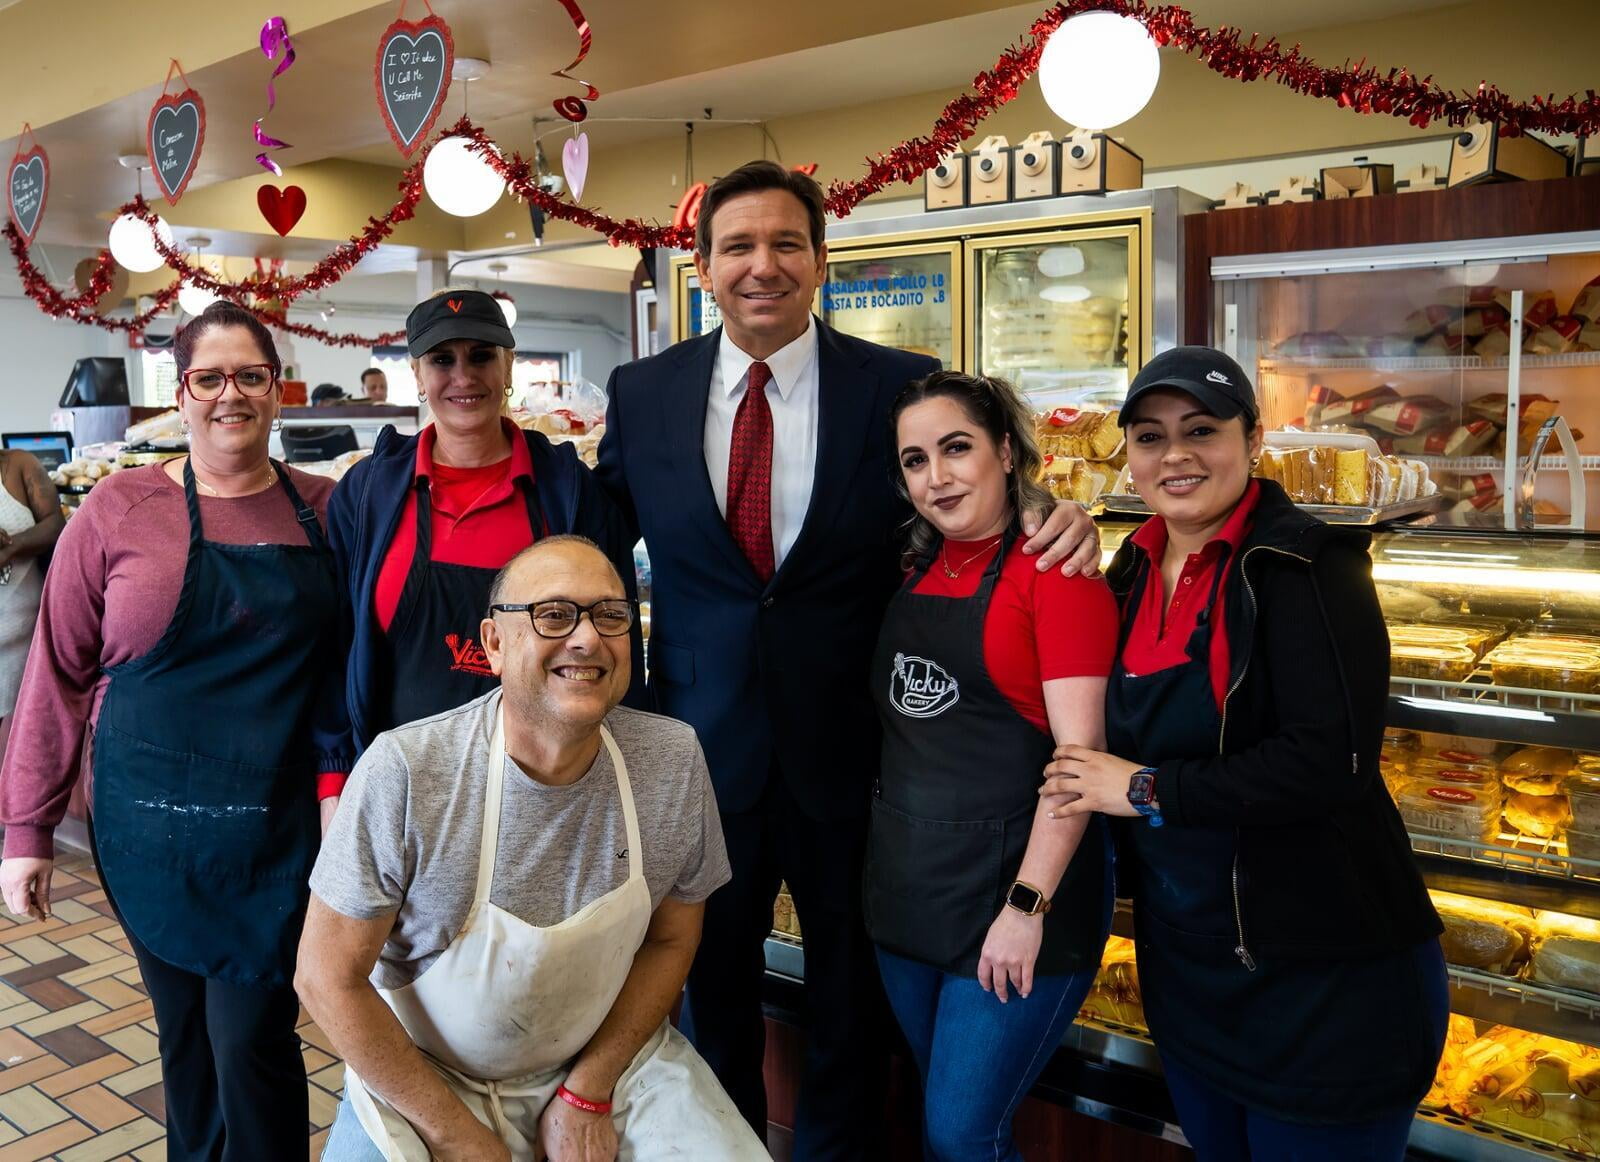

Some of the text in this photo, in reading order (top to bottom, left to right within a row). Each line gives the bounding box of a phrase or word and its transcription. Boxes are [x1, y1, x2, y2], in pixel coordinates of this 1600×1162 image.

[388, 54, 397, 66] I
[389, 72, 395, 85] U
[894, 275, 927, 290] POLLO
[932, 273, 944, 287] LB
[856, 295, 867, 309] DE
[872, 292, 924, 308] BOCADITO
[445, 633, 491, 666] Vic
[900, 660, 947, 695] Vicky
[906, 698, 930, 706] BAKERY
